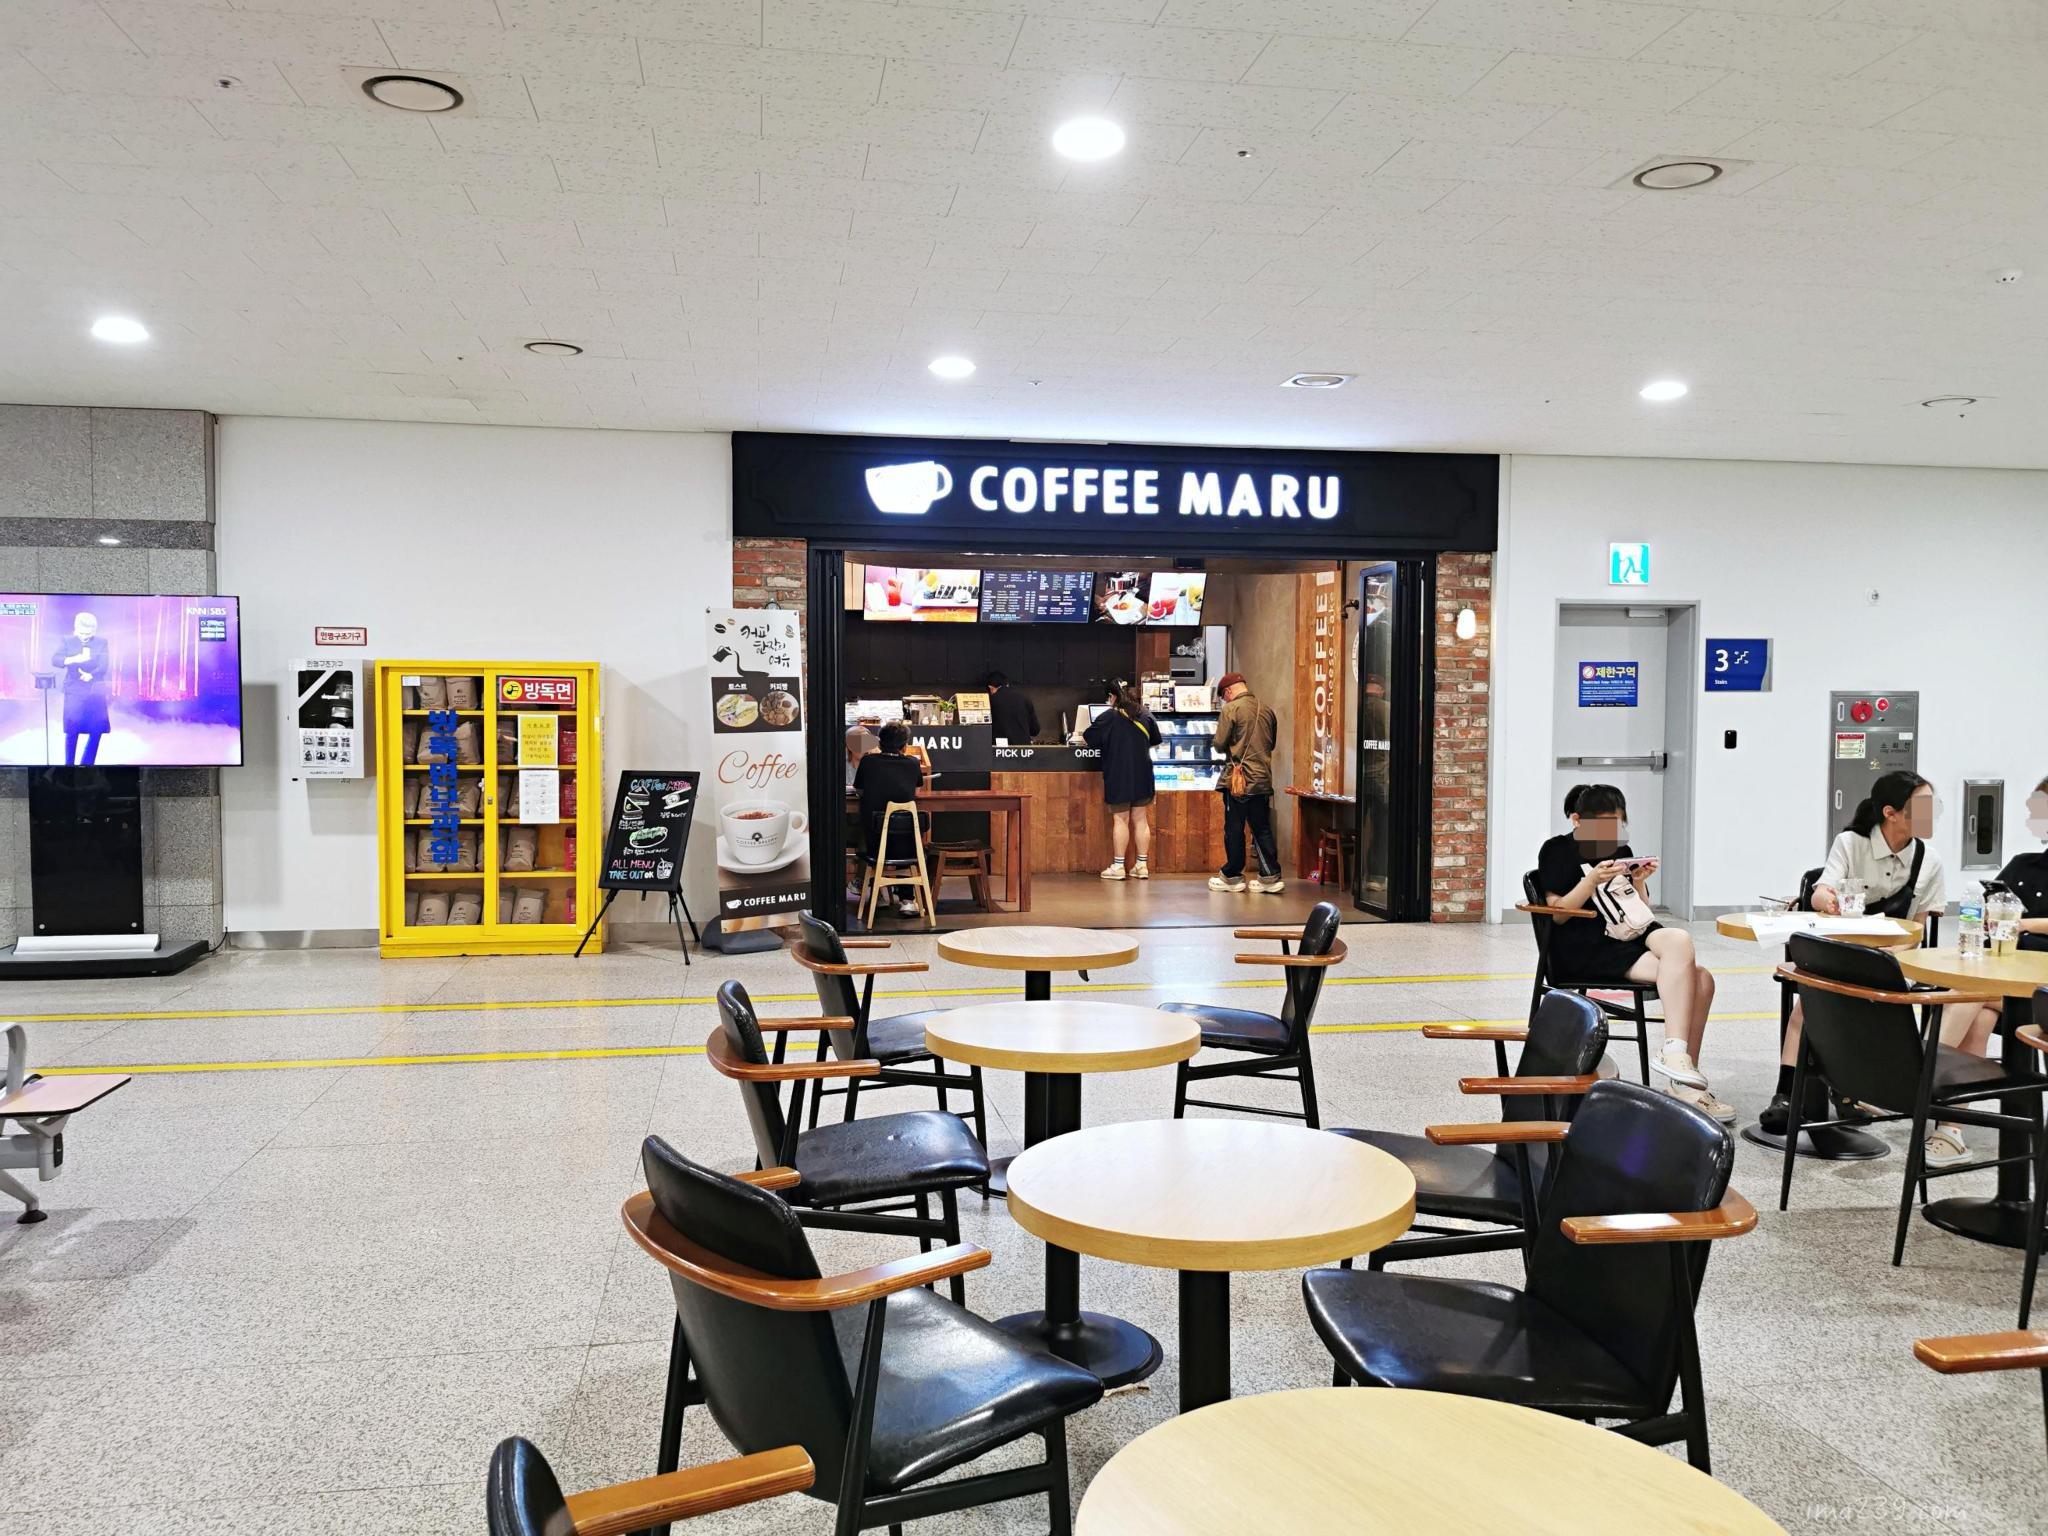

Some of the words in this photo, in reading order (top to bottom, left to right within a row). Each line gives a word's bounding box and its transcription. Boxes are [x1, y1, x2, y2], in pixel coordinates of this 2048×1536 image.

[969, 466, 1159, 514] COFFEE
[1178, 472, 1340, 520] MARU
[320, 631, 362, 641] 인명구조기구
[740, 623, 770, 640] 커피
[768, 653, 790, 668] 여유
[1314, 592, 1328, 738] COFFEE
[1714, 649, 1729, 672] 3
[1595, 666, 1636, 678] 제한구역
[524, 682, 571, 700] 방독면
[912, 736, 962, 750] MARU
[995, 749, 1019, 758] PICK
[1020, 749, 1034, 758] UP
[1074, 748, 1102, 758] ORDE
[718, 750, 799, 789] Coffee
[611, 859, 628, 869] ALL
[629, 859, 655, 869] MENU
[608, 870, 628, 879] TAKE
[743, 896, 776, 907] COFFEE
[778, 892, 806, 903] MARU
